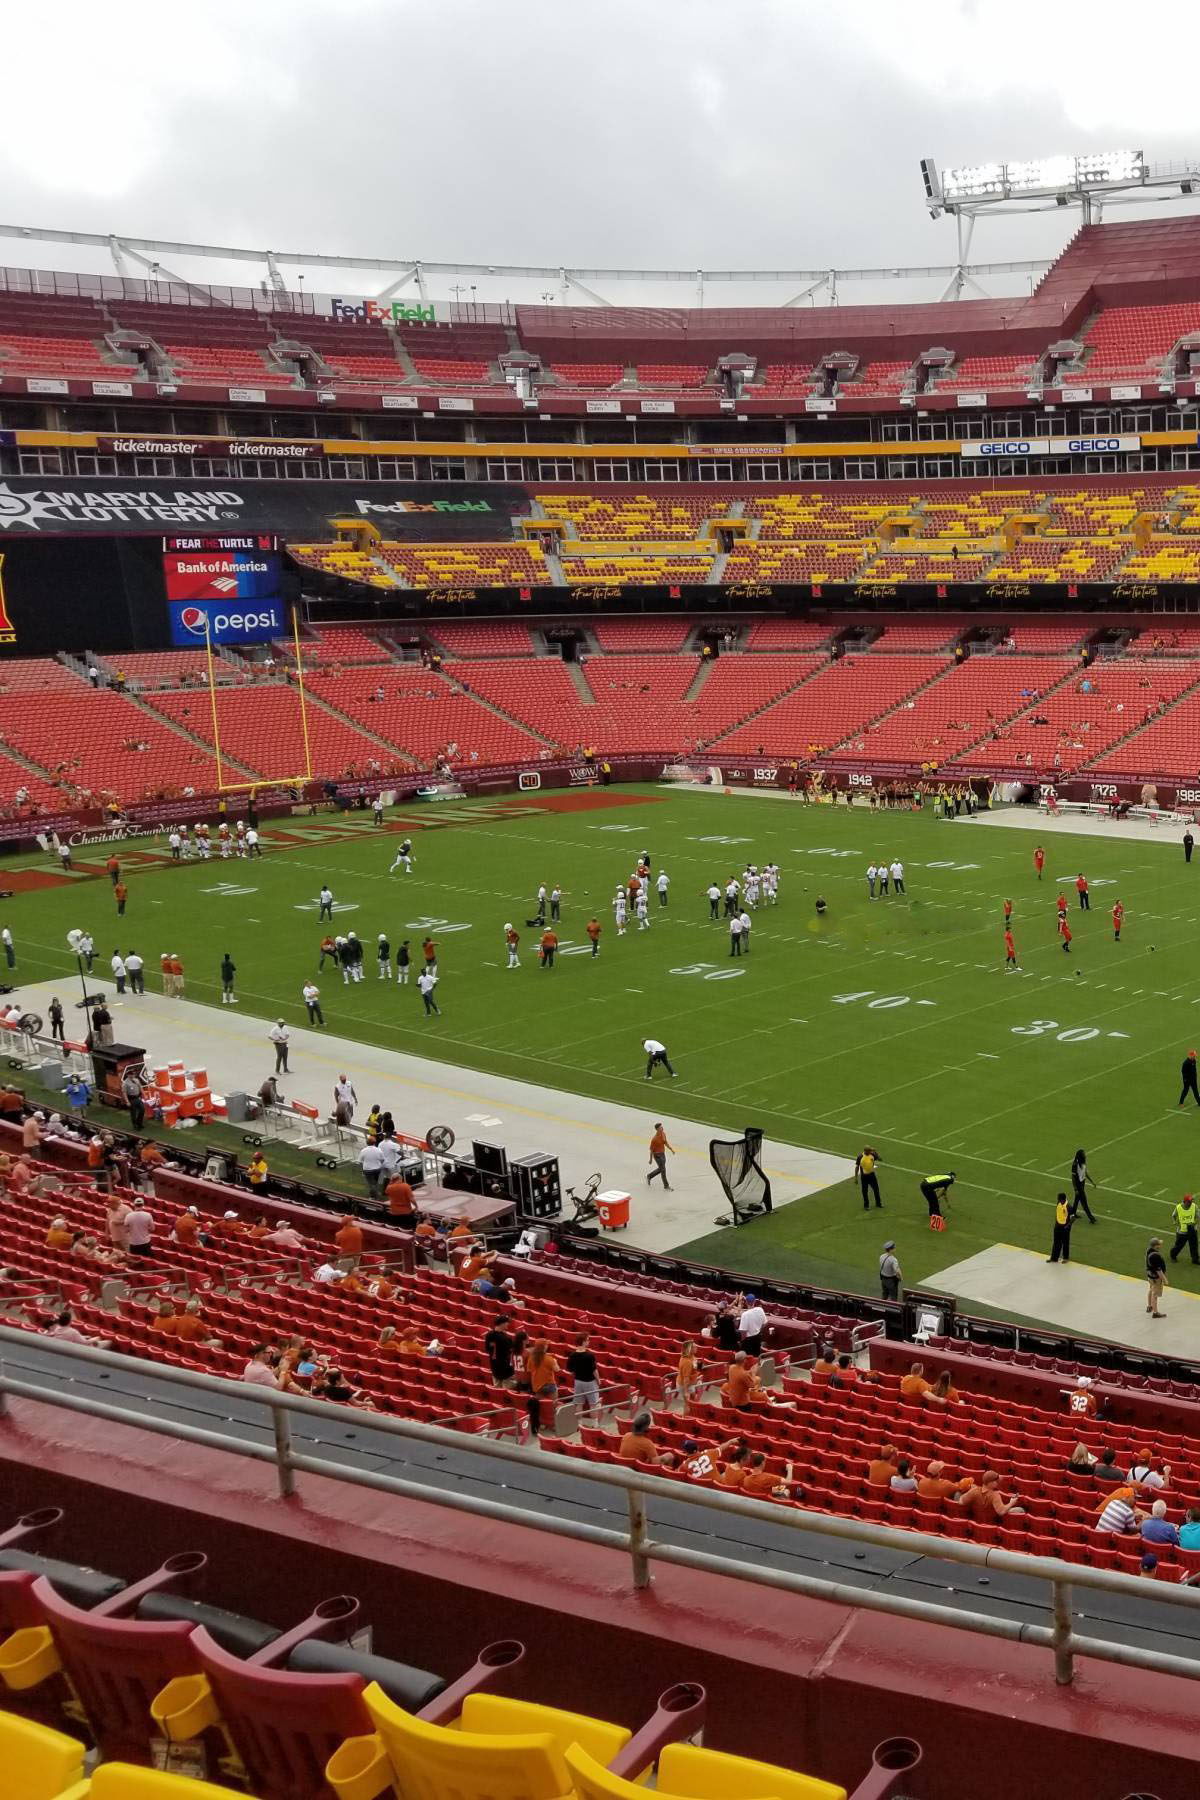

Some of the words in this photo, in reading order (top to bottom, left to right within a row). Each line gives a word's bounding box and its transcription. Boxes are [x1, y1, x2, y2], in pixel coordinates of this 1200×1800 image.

[332, 299, 435, 321] FedExField
[113, 439, 198, 454] ticketmaster
[229, 442, 307, 457] ticketmaster
[980, 442, 1030, 455] GEICO
[1068, 439, 1120, 452] GEICO
[43, 491, 244, 507] MARYLAND
[355, 500, 493, 514] FedExField
[51, 506, 222, 521] LOTTERY
[177, 561, 208, 573] Bank
[208, 561, 220, 573] of
[222, 561, 268, 573] America
[215, 610, 279, 633] pepsi
[523, 776, 537, 787] 40
[754, 769, 778, 781] 1937
[848, 774, 873, 786] 1942
[69, 830, 127, 847] Charitable
[127, 823, 180, 837] Foundati
[669, 963, 746, 980] 50
[831, 991, 911, 1009] 40
[1011, 1020, 1101, 1042] 30
[930, 1216, 941, 1230] 20
[1072, 1395, 1088, 1412] 32
[688, 1455, 714, 1478] 32
